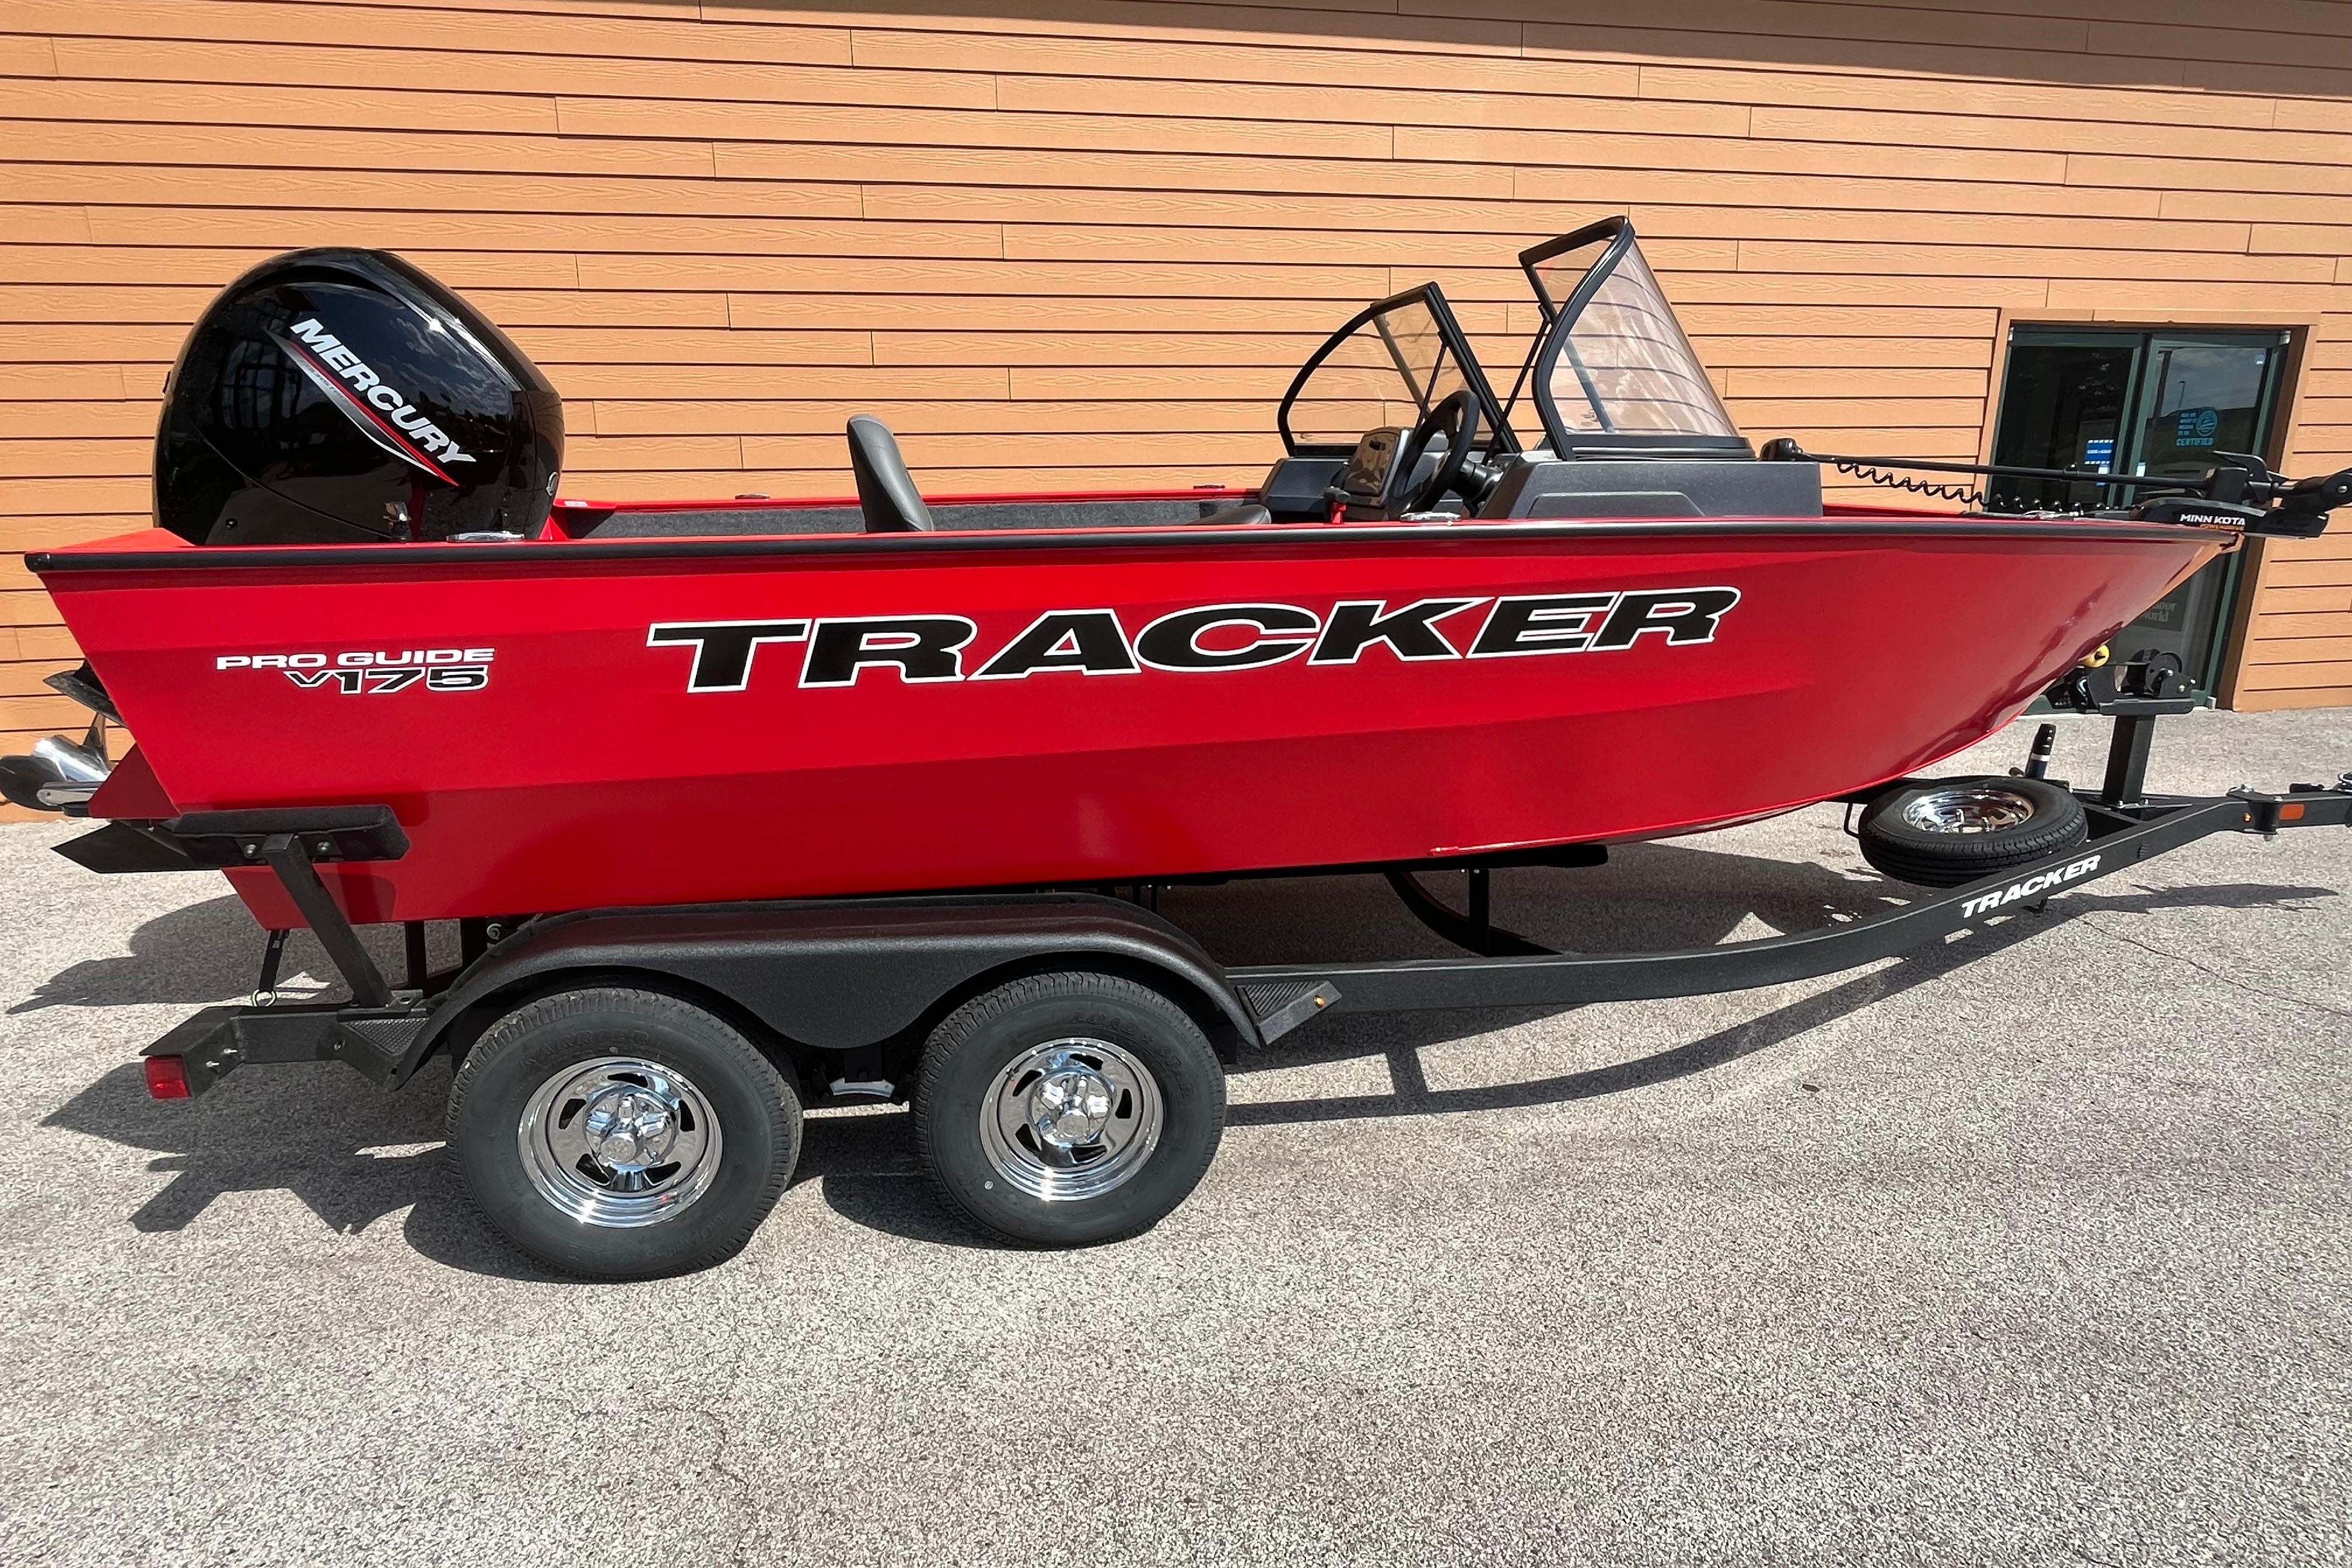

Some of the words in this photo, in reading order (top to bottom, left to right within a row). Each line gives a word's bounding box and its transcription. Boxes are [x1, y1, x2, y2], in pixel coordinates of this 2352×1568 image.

[290, 318, 477, 463] MERCURY
[2180, 514, 2213, 523] MINN
[2214, 516, 2246, 525] KOTA
[646, 586, 1741, 693] TRACKER
[216, 653, 327, 670] PRO
[337, 648, 495, 667] GUIDE
[283, 664, 489, 695] V175
[1961, 855, 2101, 918] TRACKER
[1072, 1011, 1139, 1036] LOAD
